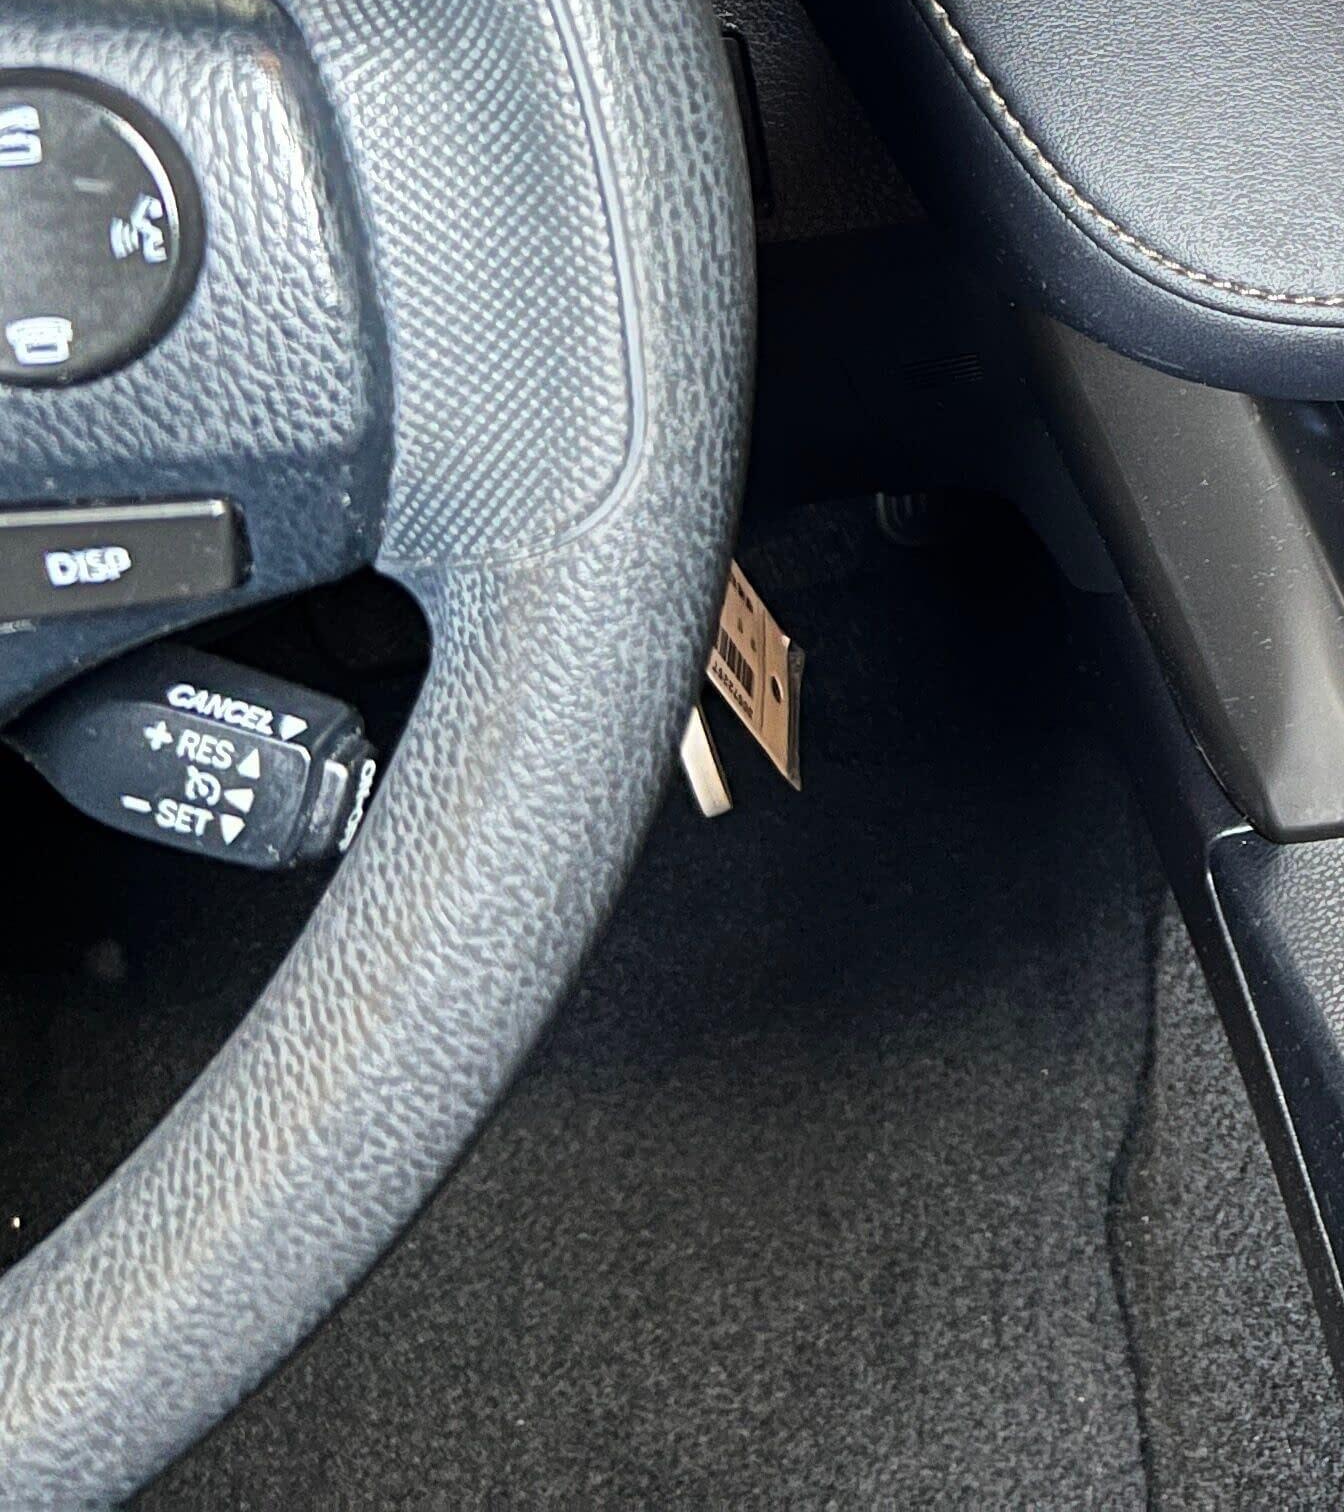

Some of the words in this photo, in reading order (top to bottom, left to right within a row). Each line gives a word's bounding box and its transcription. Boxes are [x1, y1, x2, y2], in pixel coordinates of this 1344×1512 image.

[44, 546, 133, 587] DISP
[166, 683, 274, 736] CANCEL
[176, 729, 236, 770] RES
[155, 799, 214, 837] SET
